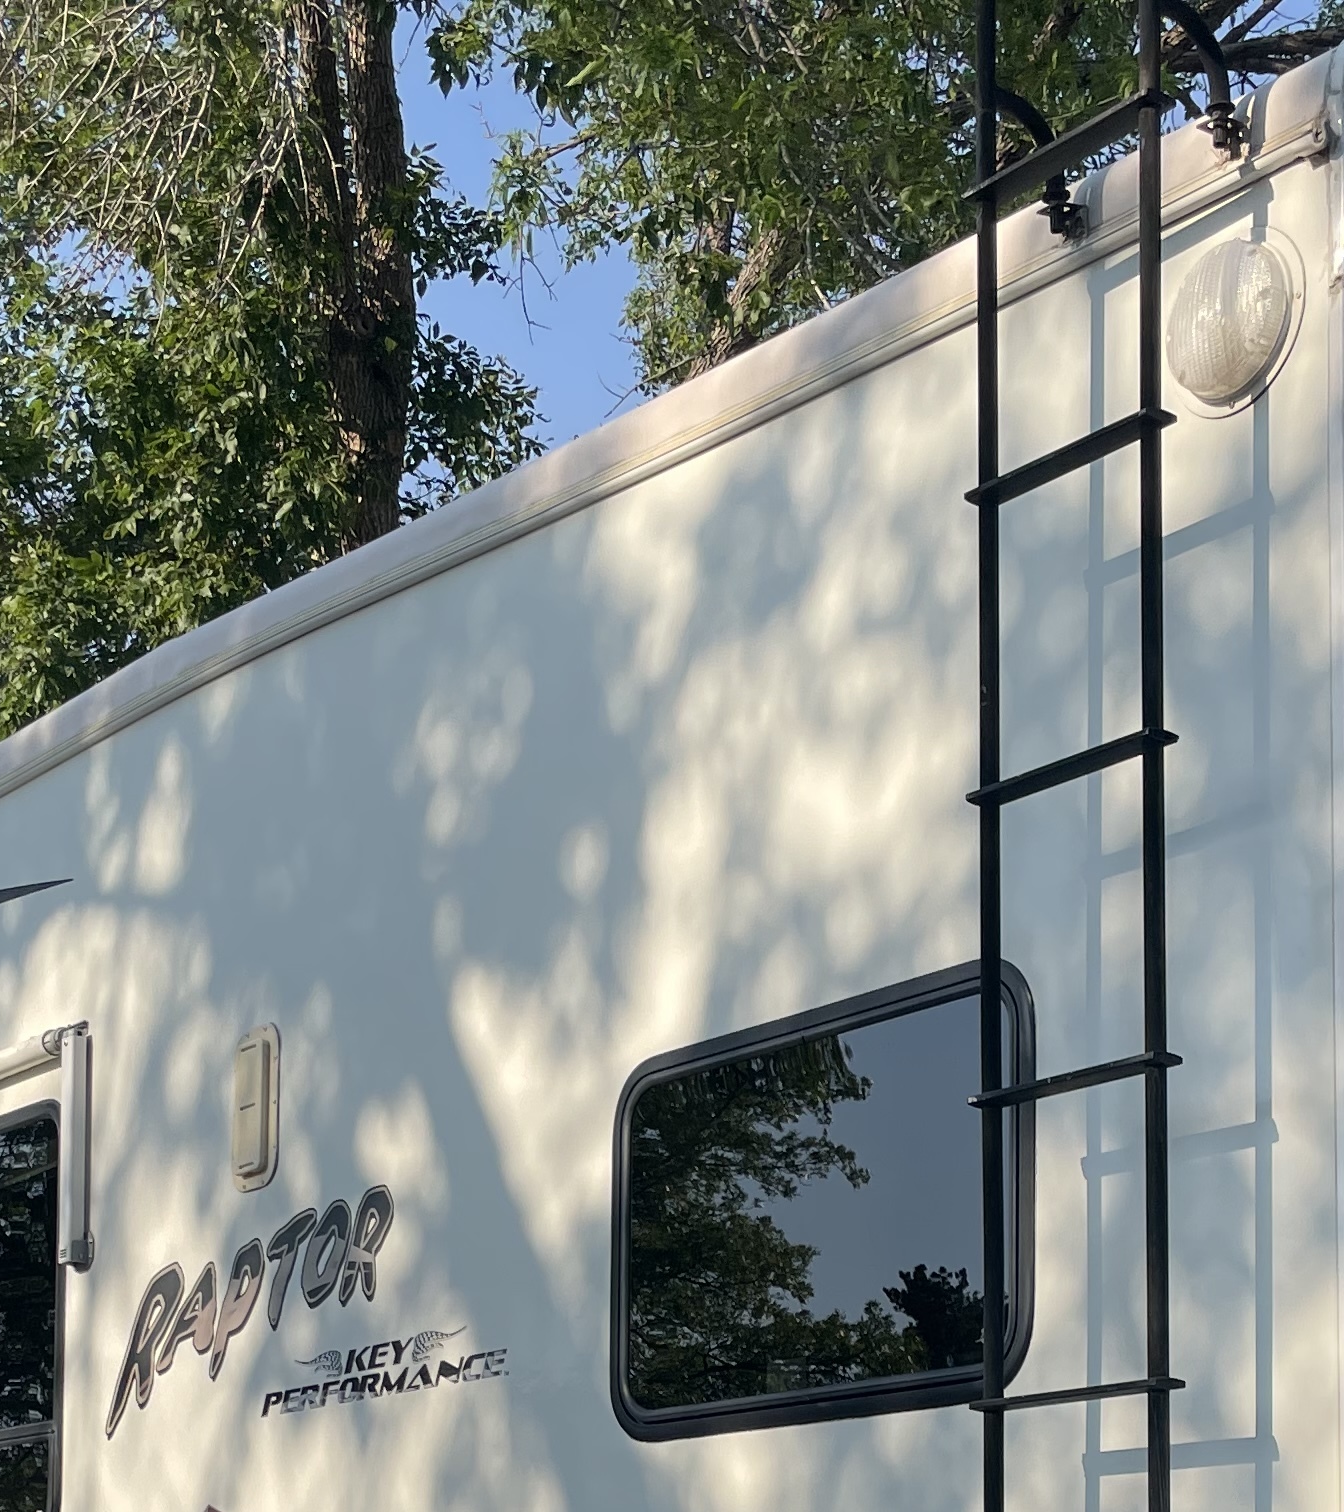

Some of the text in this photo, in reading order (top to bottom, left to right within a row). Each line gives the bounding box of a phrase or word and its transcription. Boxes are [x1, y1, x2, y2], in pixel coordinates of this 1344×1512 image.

[105, 1184, 394, 1440] RAPTOR
[261, 1348, 508, 1418] PERFORMANCE
[344, 1337, 414, 1374] KEY
